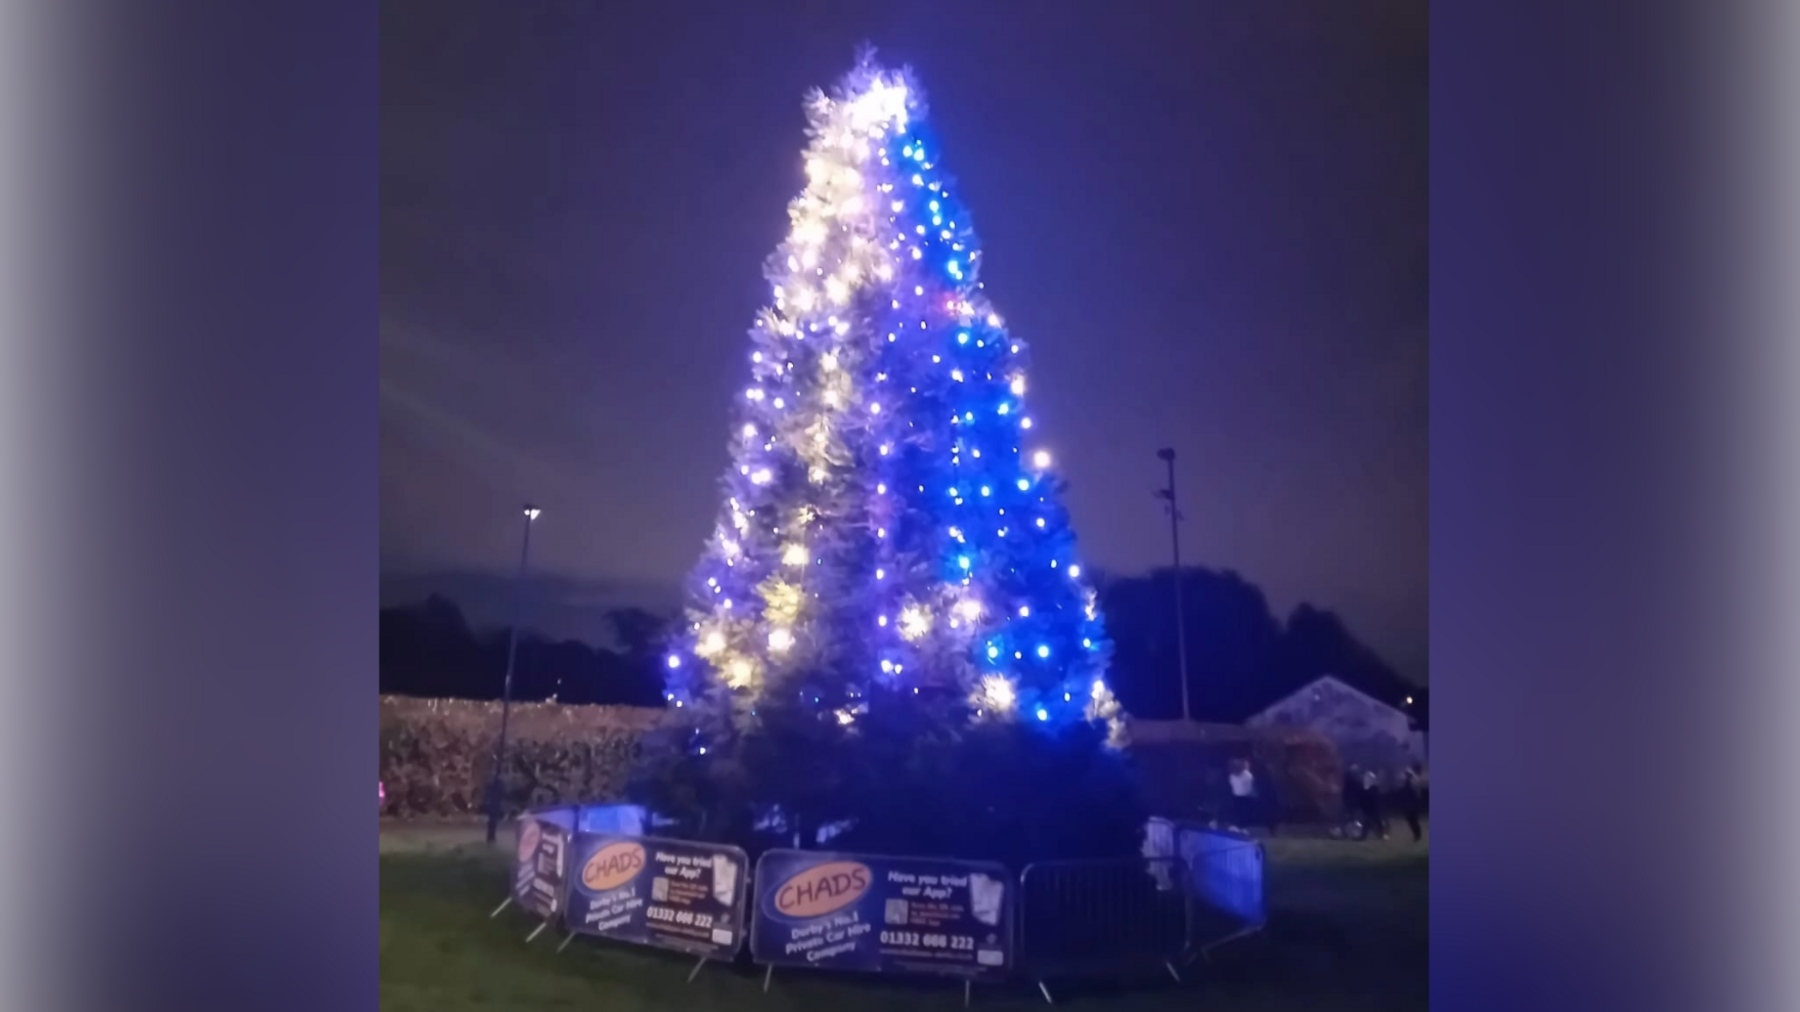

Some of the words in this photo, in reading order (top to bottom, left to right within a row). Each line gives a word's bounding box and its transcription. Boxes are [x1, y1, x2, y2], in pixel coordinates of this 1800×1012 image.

[585, 846, 642, 884] CHADS
[779, 866, 867, 910] CHADS
[888, 870, 916, 883] Have
[918, 875, 939, 886] you
[647, 906, 675, 922] 01332
[695, 914, 713, 928] 222
[826, 930, 845, 943] Car
[880, 930, 920, 946] 01332
[950, 935, 975, 950] 222
